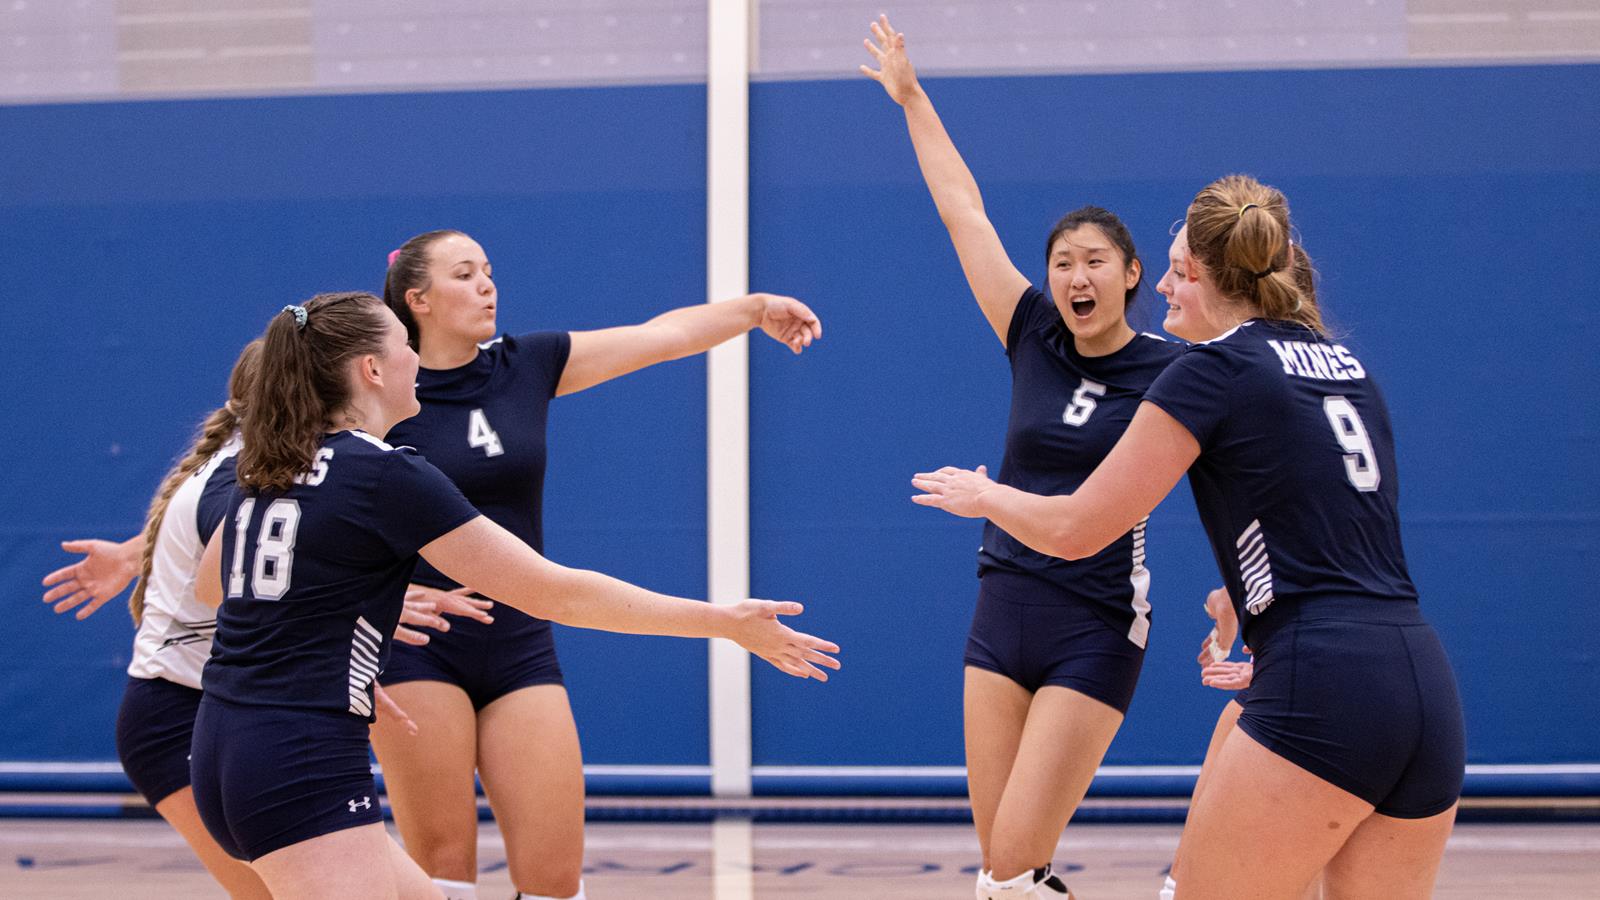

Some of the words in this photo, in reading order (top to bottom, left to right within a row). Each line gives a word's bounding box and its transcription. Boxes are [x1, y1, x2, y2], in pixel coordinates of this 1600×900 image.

[1267, 340, 1366, 381] MINES
[1063, 378, 1107, 427] 5
[467, 408, 505, 457] 4
[1323, 395, 1381, 492] 9
[227, 497, 302, 601] 18
